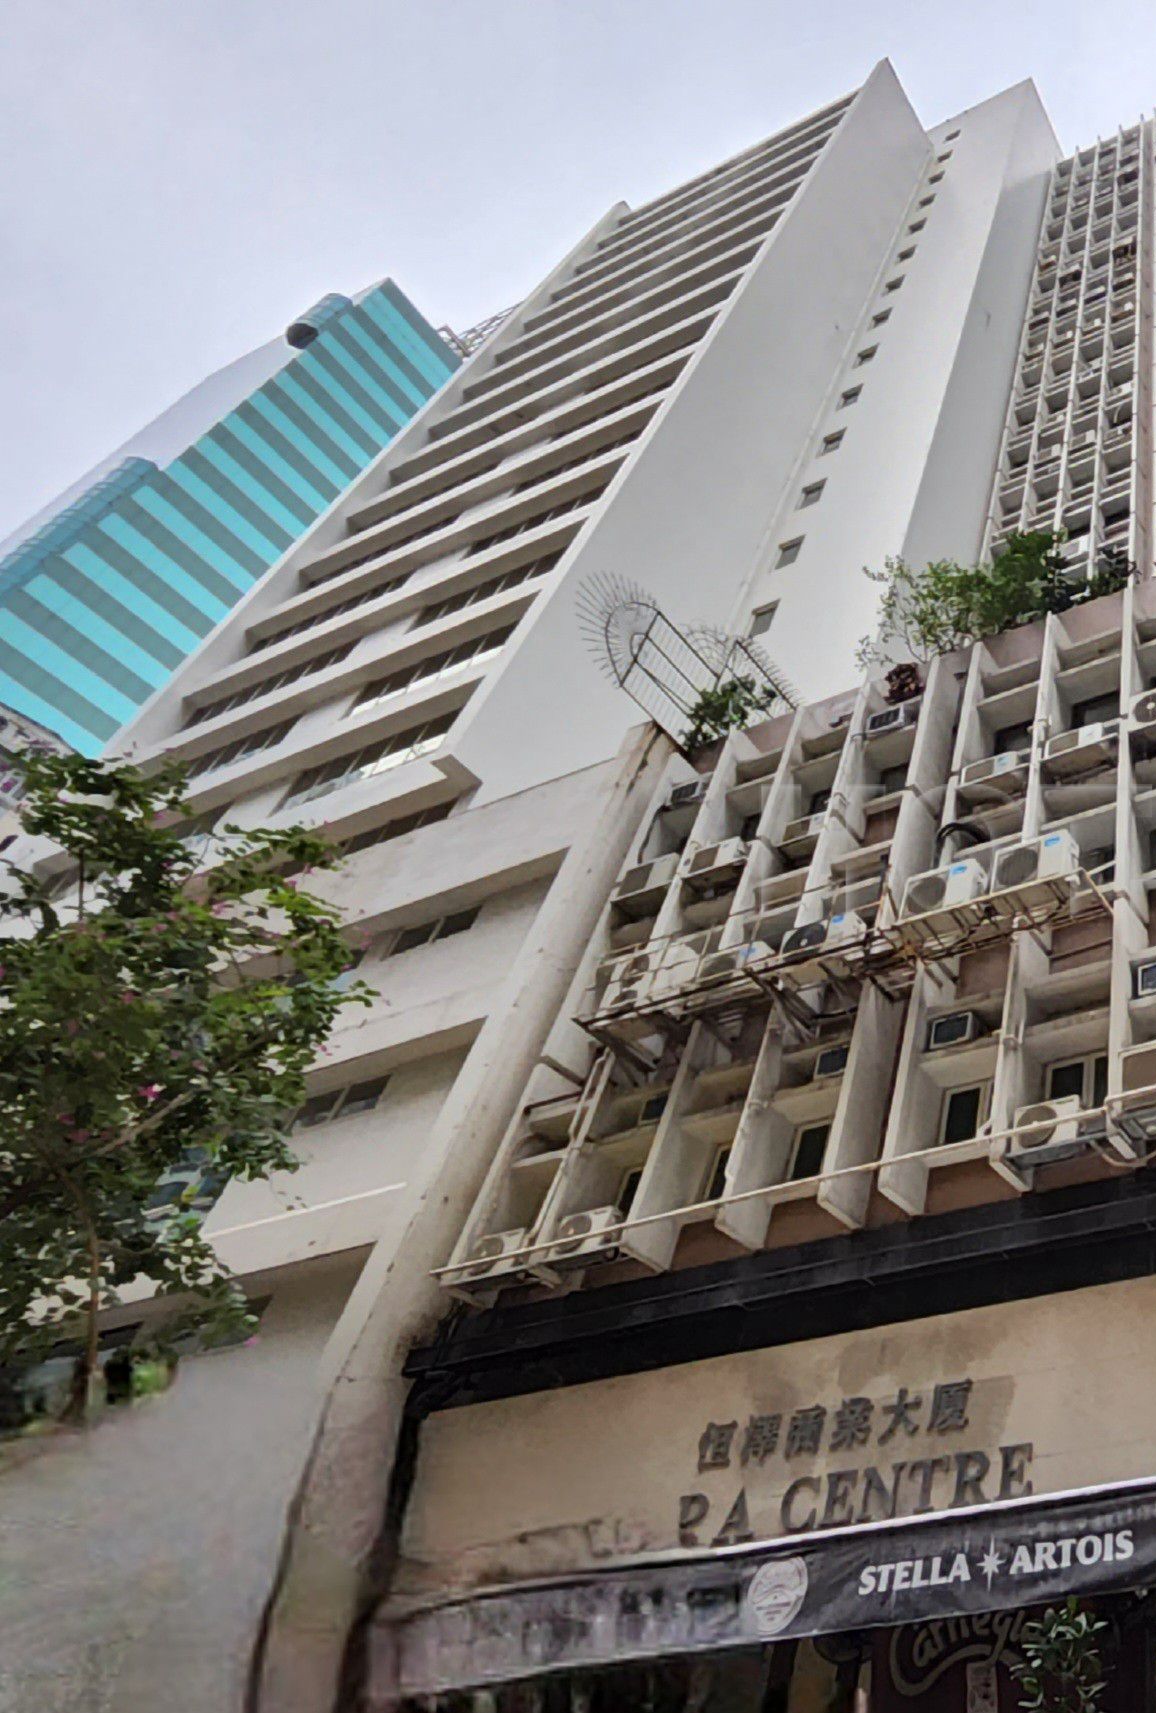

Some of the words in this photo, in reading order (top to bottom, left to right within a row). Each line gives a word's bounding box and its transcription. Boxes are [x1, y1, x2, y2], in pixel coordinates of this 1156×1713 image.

[780, 1442, 1033, 1534] CENTRE
[858, 1553, 971, 1596] STELLA
[1009, 1530, 1134, 1575] ARTOIS
